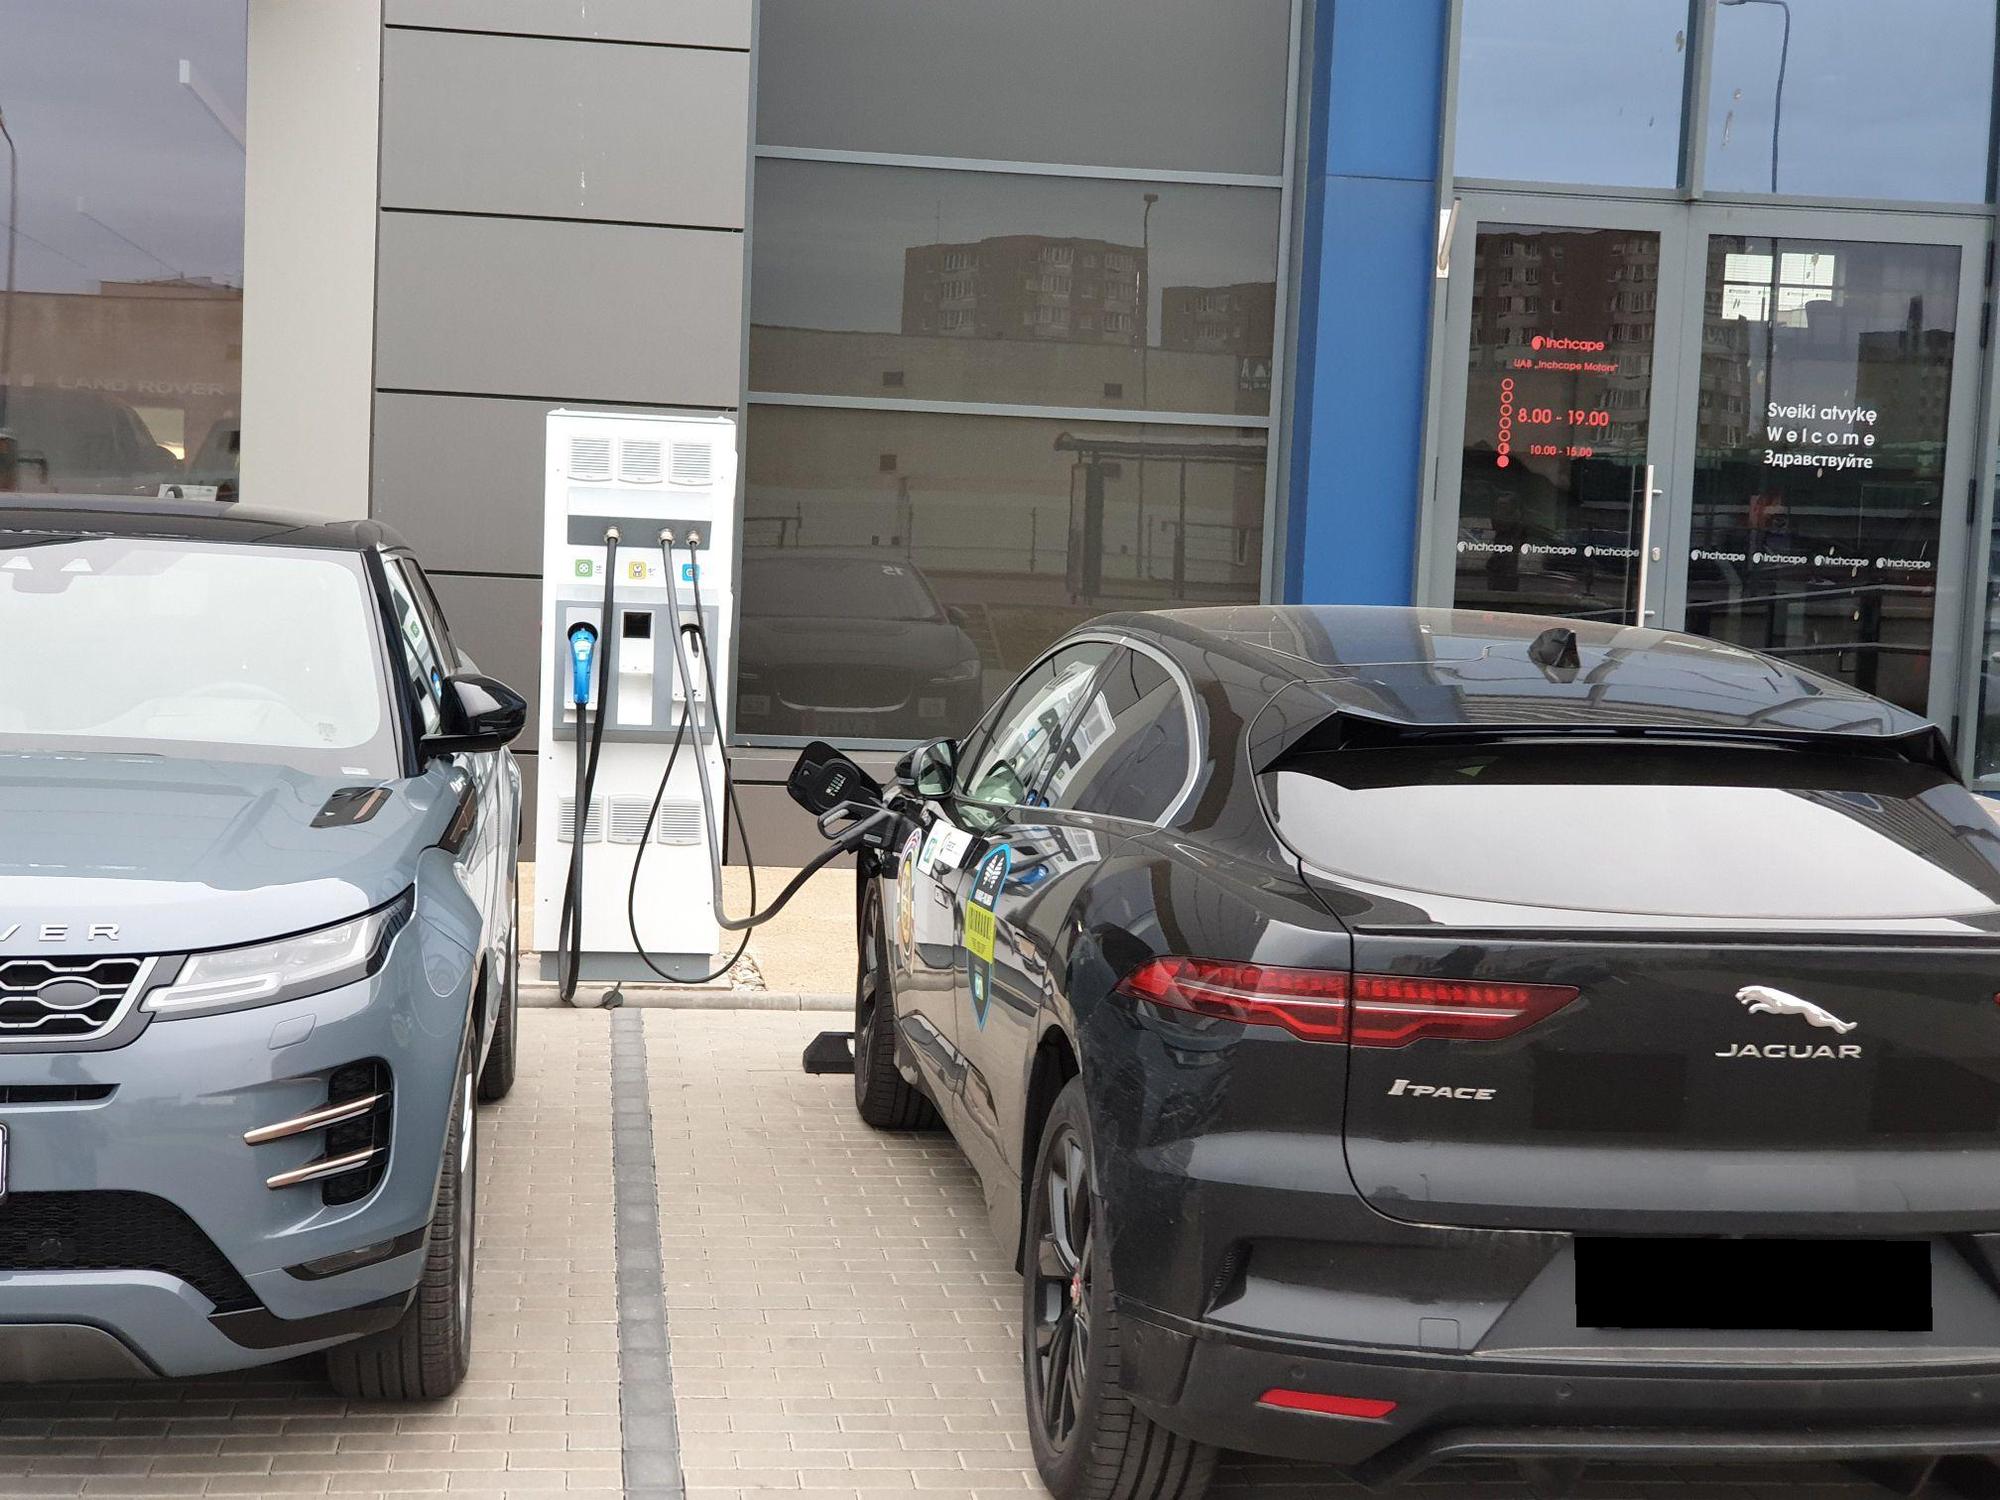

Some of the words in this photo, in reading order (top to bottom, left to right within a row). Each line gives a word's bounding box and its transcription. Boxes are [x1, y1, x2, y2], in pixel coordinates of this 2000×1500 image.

[1545, 337, 1604, 352] Inchcape
[1513, 359, 1532, 368] UAB
[1517, 408, 1552, 424] 8.00
[1568, 410, 1609, 427] 19.00
[1767, 402, 1816, 419] Sveiki
[1820, 405, 1877, 426] atvykę
[1767, 426, 1875, 446] Welcome
[1530, 445, 1557, 456] 10.00
[1763, 449, 1873, 471] Здравствуйте
[1468, 541, 1513, 553] Inchcape
[1532, 543, 1577, 556] Inchcape
[1595, 546, 1640, 558] Inchcape
[1701, 550, 1746, 562] Inchcape
[1763, 553, 1807, 565] Inchcape
[1825, 555, 1870, 567] Inchcape
[1887, 558, 1931, 569] Inchcape
[1714, 1043, 1862, 1059] JAGUAR
